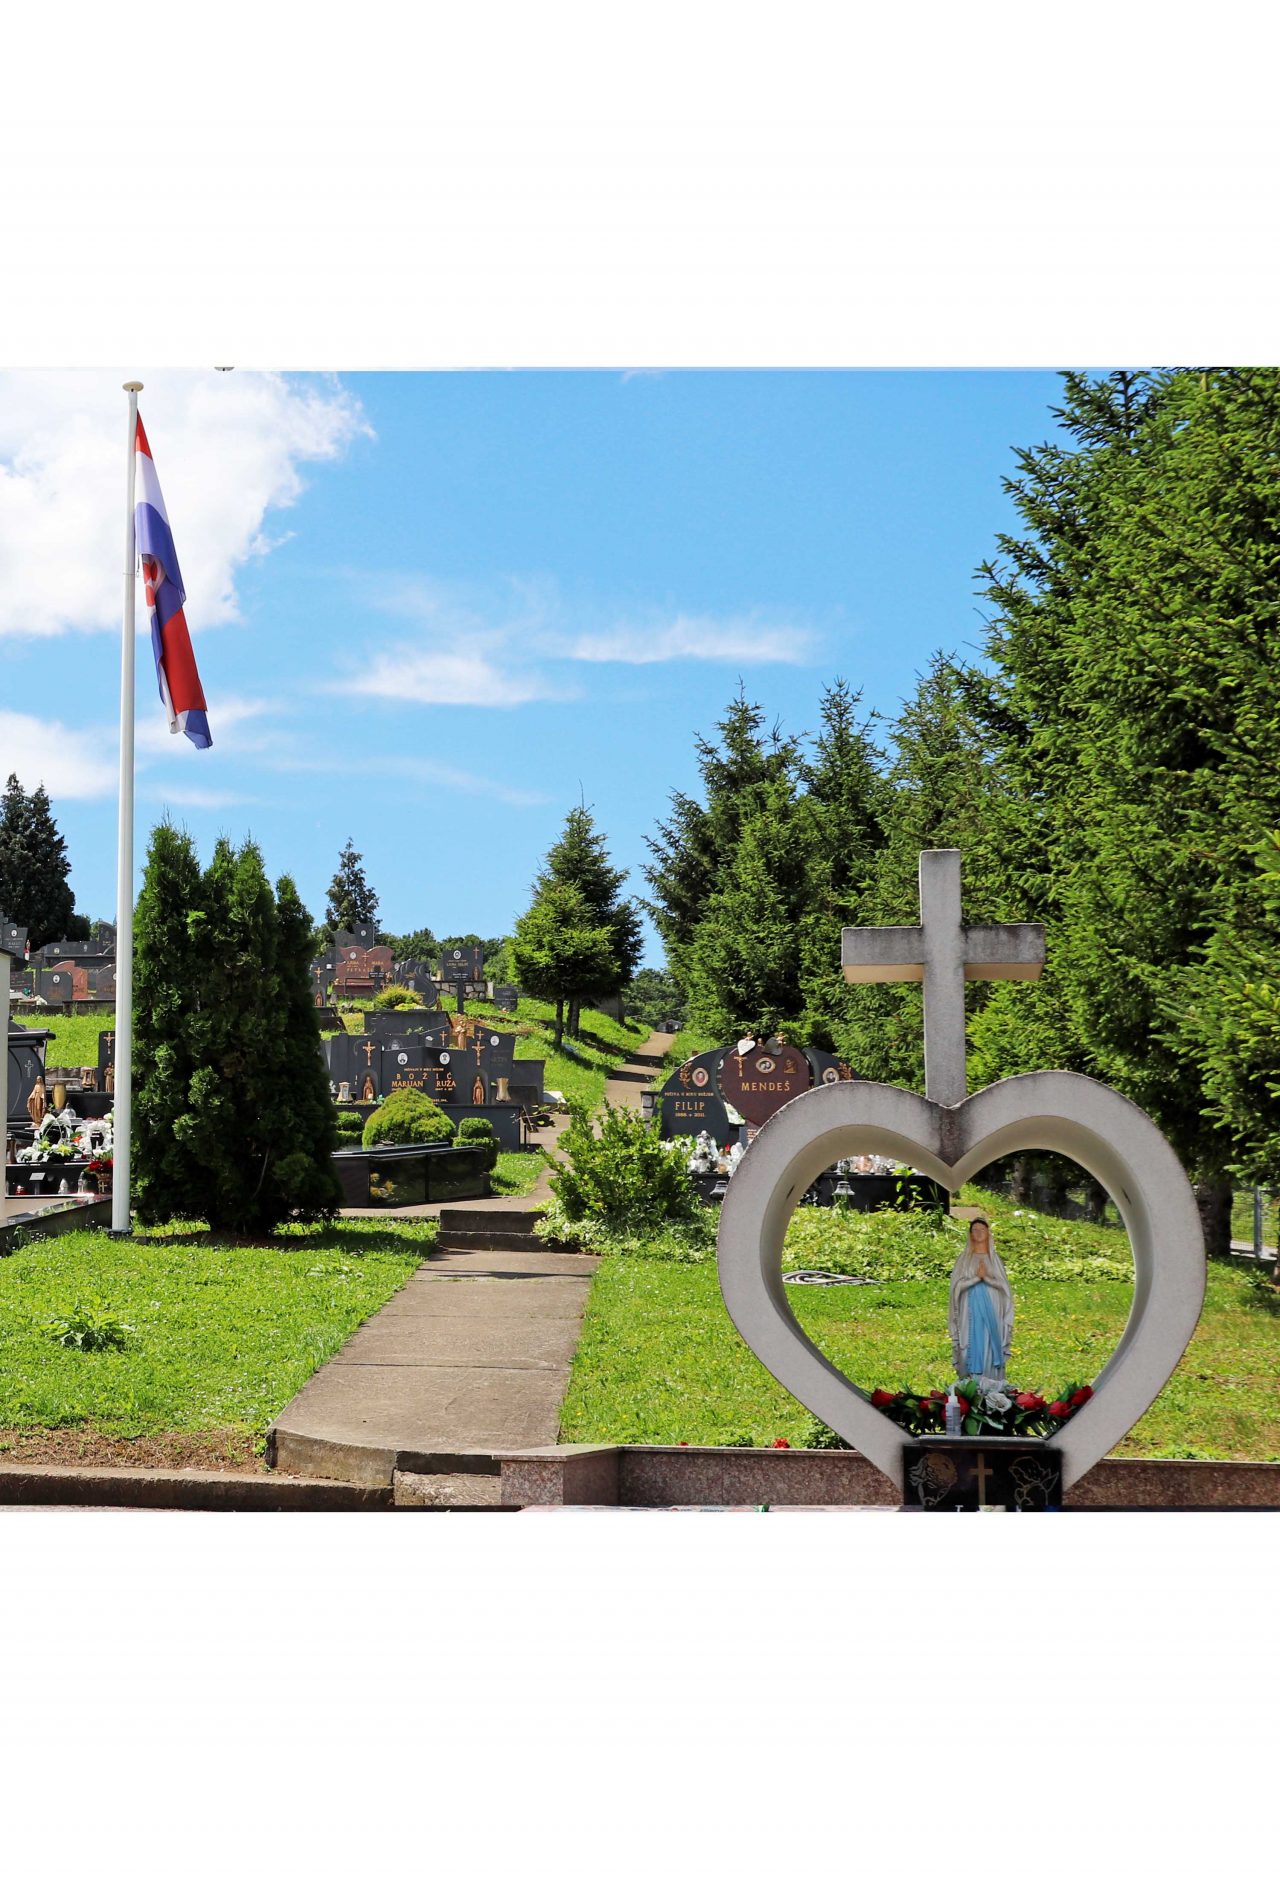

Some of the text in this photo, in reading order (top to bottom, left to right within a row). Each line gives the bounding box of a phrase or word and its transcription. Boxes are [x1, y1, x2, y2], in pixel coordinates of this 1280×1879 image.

[396, 1071, 452, 1080] BOŽIĆ
[436, 1079, 457, 1087] RUŽA
[741, 1080, 790, 1091] MENDEŠ
[675, 1101, 705, 1111] FILIP
